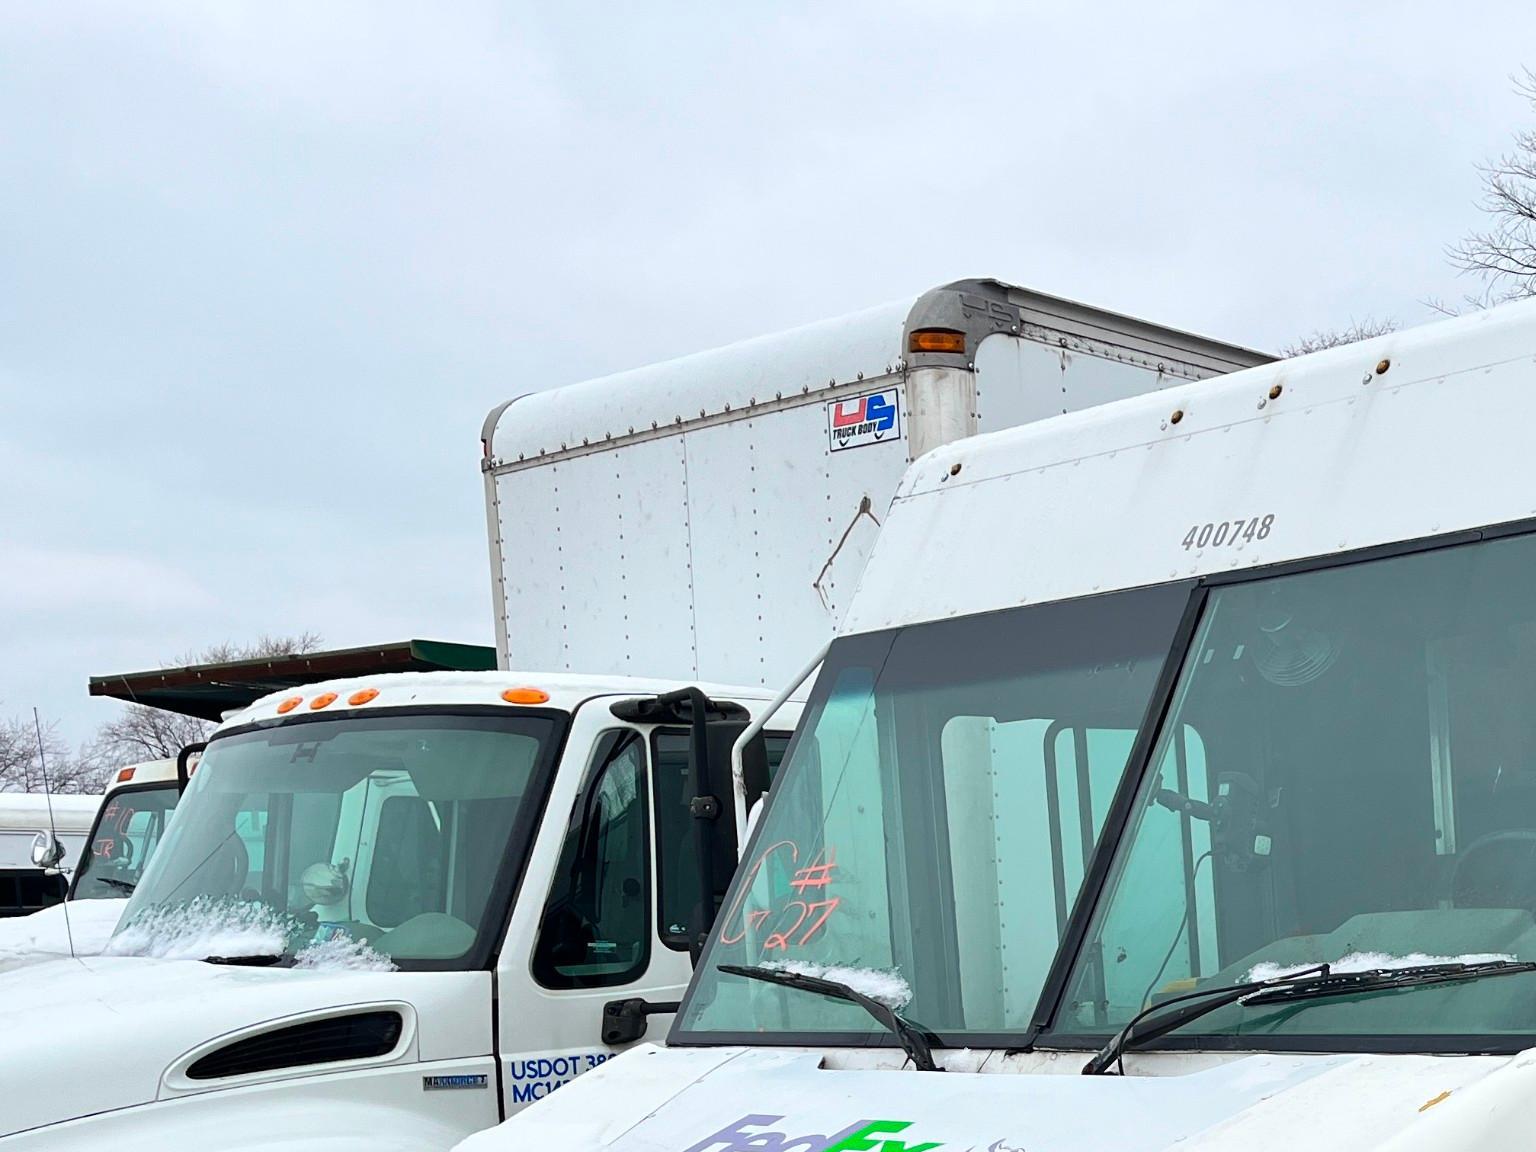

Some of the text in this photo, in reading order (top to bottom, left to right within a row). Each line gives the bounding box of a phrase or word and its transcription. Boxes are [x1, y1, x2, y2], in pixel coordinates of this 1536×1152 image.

[833, 395, 896, 431] US
[832, 422, 877, 439] TRUCK BODY
[1181, 514, 1275, 551] 400748
[511, 1056, 581, 1080] USDOT
